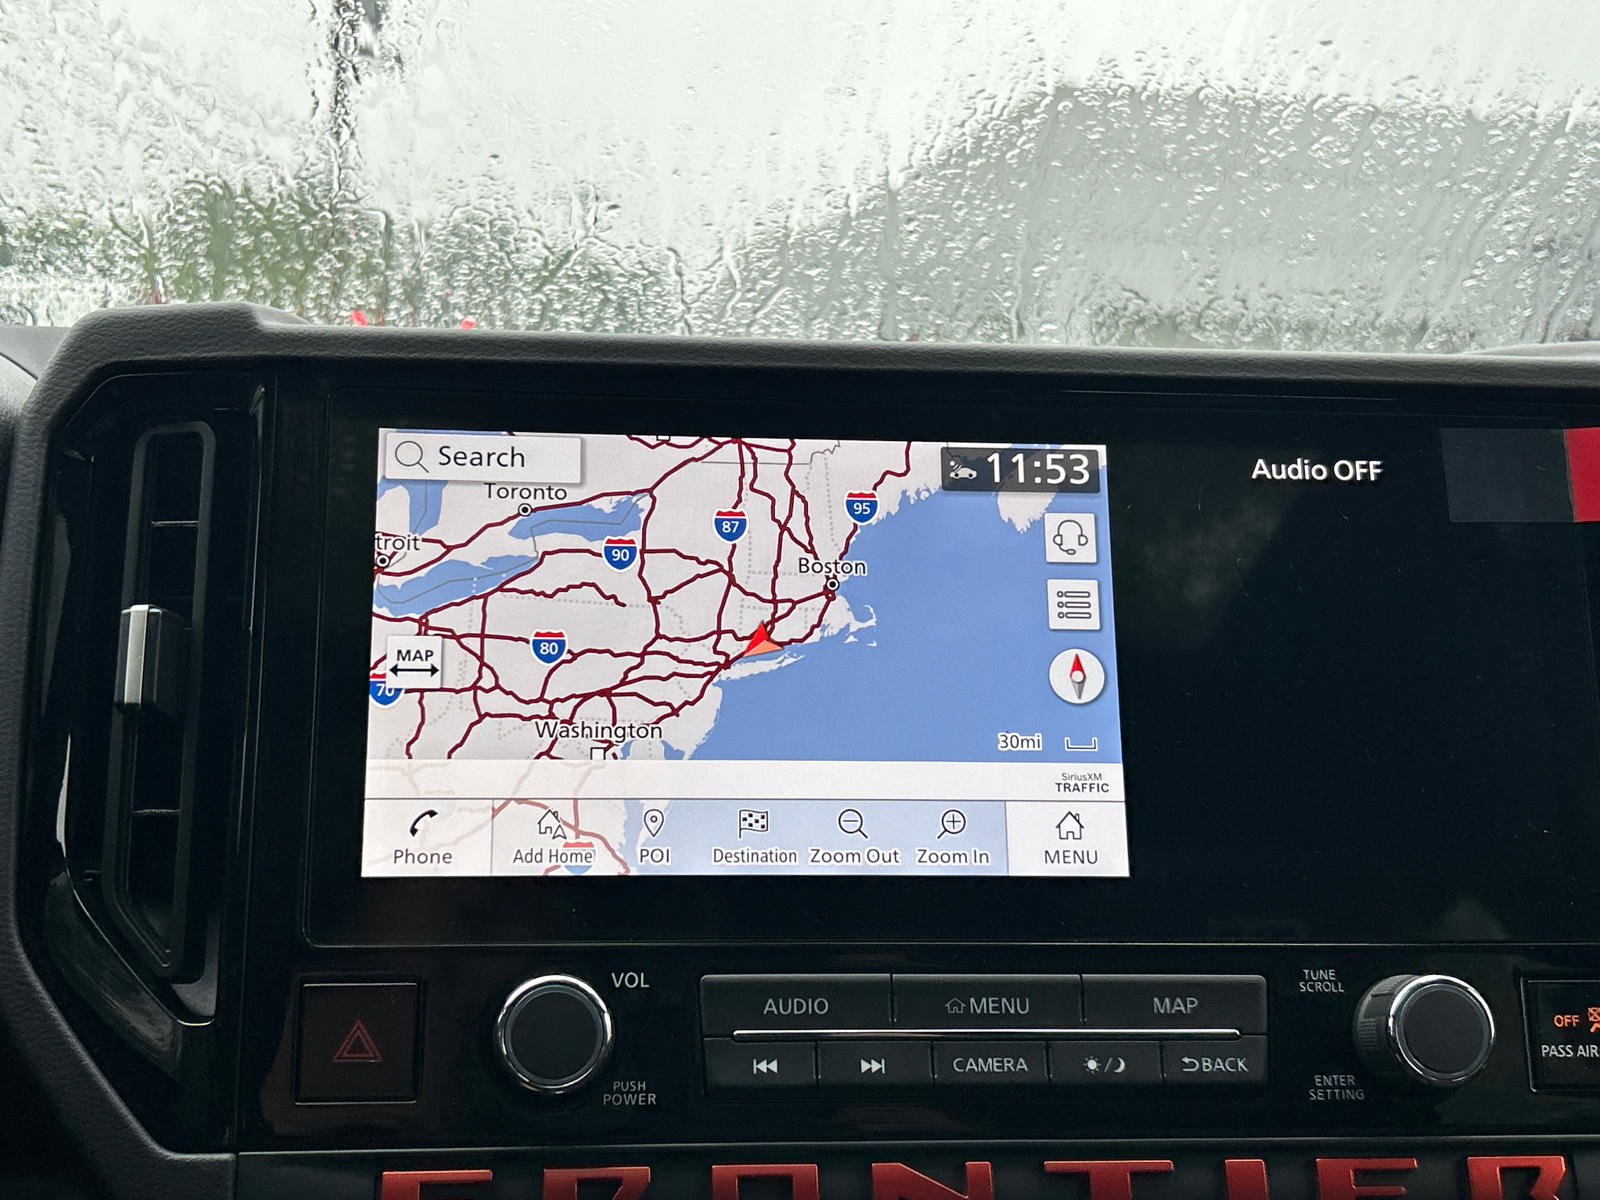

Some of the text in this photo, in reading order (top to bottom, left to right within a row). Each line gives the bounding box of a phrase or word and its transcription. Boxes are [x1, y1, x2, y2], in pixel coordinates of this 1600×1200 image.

[438, 445, 525, 468] Search
[986, 452, 1090, 486] 11:53
[1252, 458, 1383, 481] Audio OFF
[486, 483, 567, 501] Toronto
[853, 502, 871, 516] 95
[721, 520, 739, 534] 87
[375, 534, 420, 551] troit
[611, 549, 630, 562] 90
[799, 558, 867, 575] Boston
[396, 649, 434, 662] MAP
[540, 642, 559, 656] 80
[536, 721, 663, 742] Washington
[999, 734, 1042, 750] 30mi
[1061, 772, 1102, 782] SiriusXM
[1055, 782, 1110, 793] TRAFFIC
[393, 849, 453, 864] Phone
[512, 847, 593, 864] Add Home
[639, 849, 671, 864] POI
[713, 848, 798, 864] Destination
[810, 848, 900, 864] Zoom Out
[917, 849, 990, 864] Zoom In
[1044, 849, 1099, 865] MENU
[611, 972, 650, 989] VOL
[1303, 969, 1336, 981] TUNE
[1299, 982, 1345, 994] SCROLL
[763, 998, 829, 1015] AUDIO
[969, 998, 1030, 1014] MENU
[1153, 998, 1198, 1014] MAP
[1553, 1015, 1580, 1027] OFF
[1541, 1045, 1599, 1058] PASS AIR
[953, 1058, 1028, 1073] CAMERA
[1202, 1058, 1249, 1072] BACK
[613, 1081, 646, 1092] PUSH
[1314, 1075, 1356, 1087] ENTER
[603, 1093, 656, 1105] POWER
[1308, 1089, 1365, 1101] SETTING
